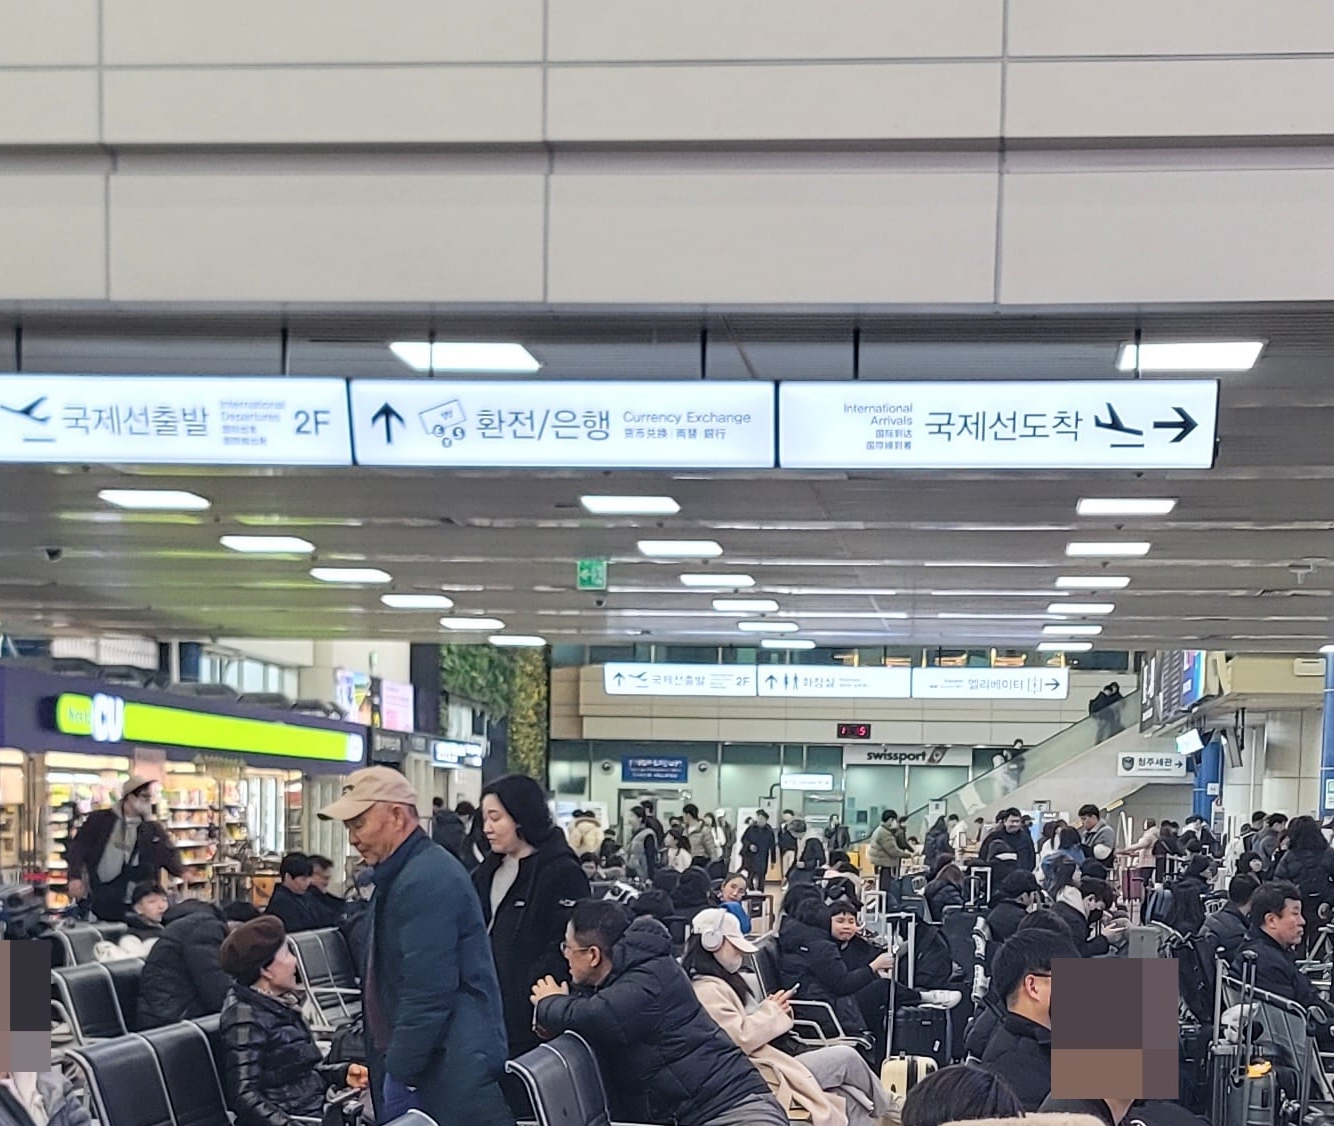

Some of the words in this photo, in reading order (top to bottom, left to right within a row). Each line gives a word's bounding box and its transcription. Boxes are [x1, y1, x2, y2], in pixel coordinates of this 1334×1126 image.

[623, 410, 682, 425] Currency
[686, 411, 752, 424] Exchange
[844, 402, 913, 414] International
[61, 404, 210, 437] 국제선출발
[294, 409, 331, 435] 2F
[476, 409, 610, 441] 환전/은행
[870, 415, 913, 426] Arrivals
[924, 410, 1084, 442] 국제선도착
[736, 676, 751, 686] 2F
[93, 692, 124, 742] CU
[867, 748, 927, 764] swissport
